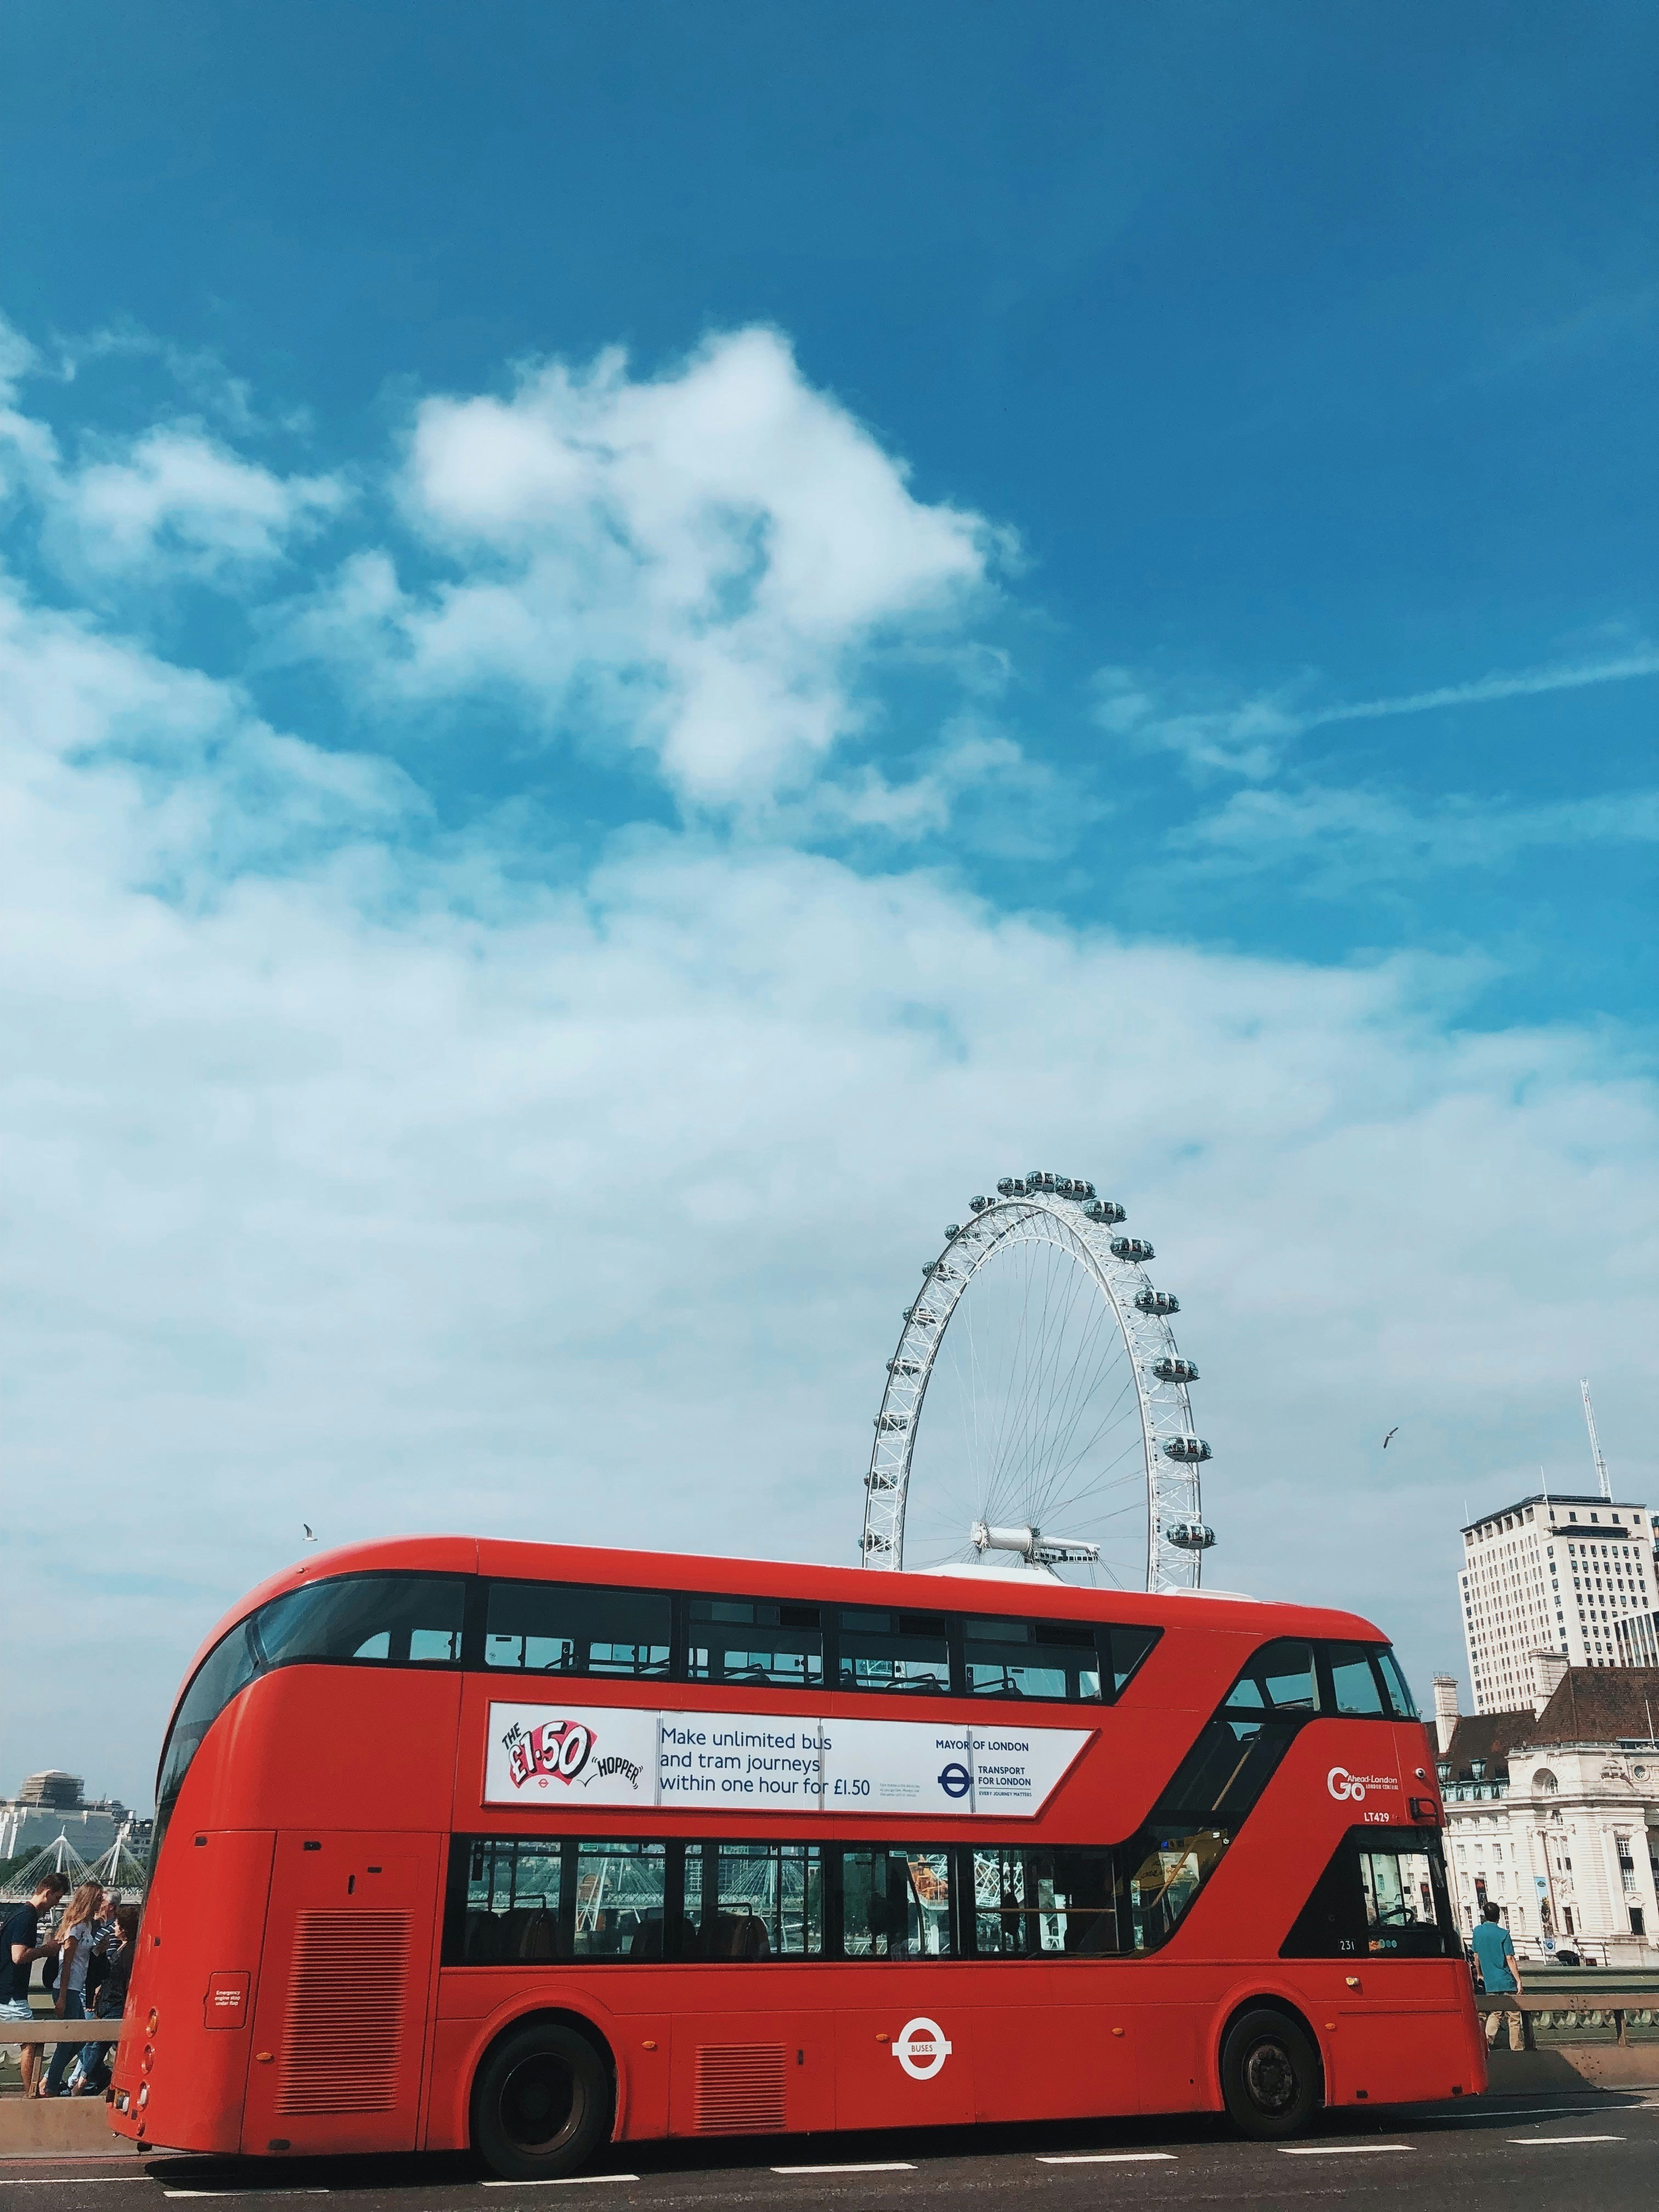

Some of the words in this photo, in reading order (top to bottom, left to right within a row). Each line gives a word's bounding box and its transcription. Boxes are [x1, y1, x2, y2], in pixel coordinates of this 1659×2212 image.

[502, 1722, 522, 1750] THE
[662, 1728, 706, 1745] Make
[713, 1731, 795, 1749] unlimited
[802, 1734, 832, 1750] bus
[936, 1740, 970, 1750] MAYOR
[973, 1741, 985, 1750] OF
[989, 1741, 1029, 1752] LONDON
[509, 1721, 592, 1785] £1.50
[660, 1752, 692, 1768] and
[698, 1753, 741, 1769] tram
[746, 1754, 821, 1775] journeys
[978, 1766, 1025, 1775] TRANSPORT
[660, 1775, 715, 1791] within
[721, 1780, 754, 1792] one
[759, 1777, 799, 1793] hour
[803, 1778, 829, 1794] for
[834, 1779, 870, 1796] £1.50
[996, 1778, 1031, 1786] LONDON
[1328, 1767, 1365, 1801] Go
[1347, 1775, 1397, 1784] Ahead-London
[1364, 1812, 1390, 1822] LT429
[1340, 1940, 1355, 1950] 231
